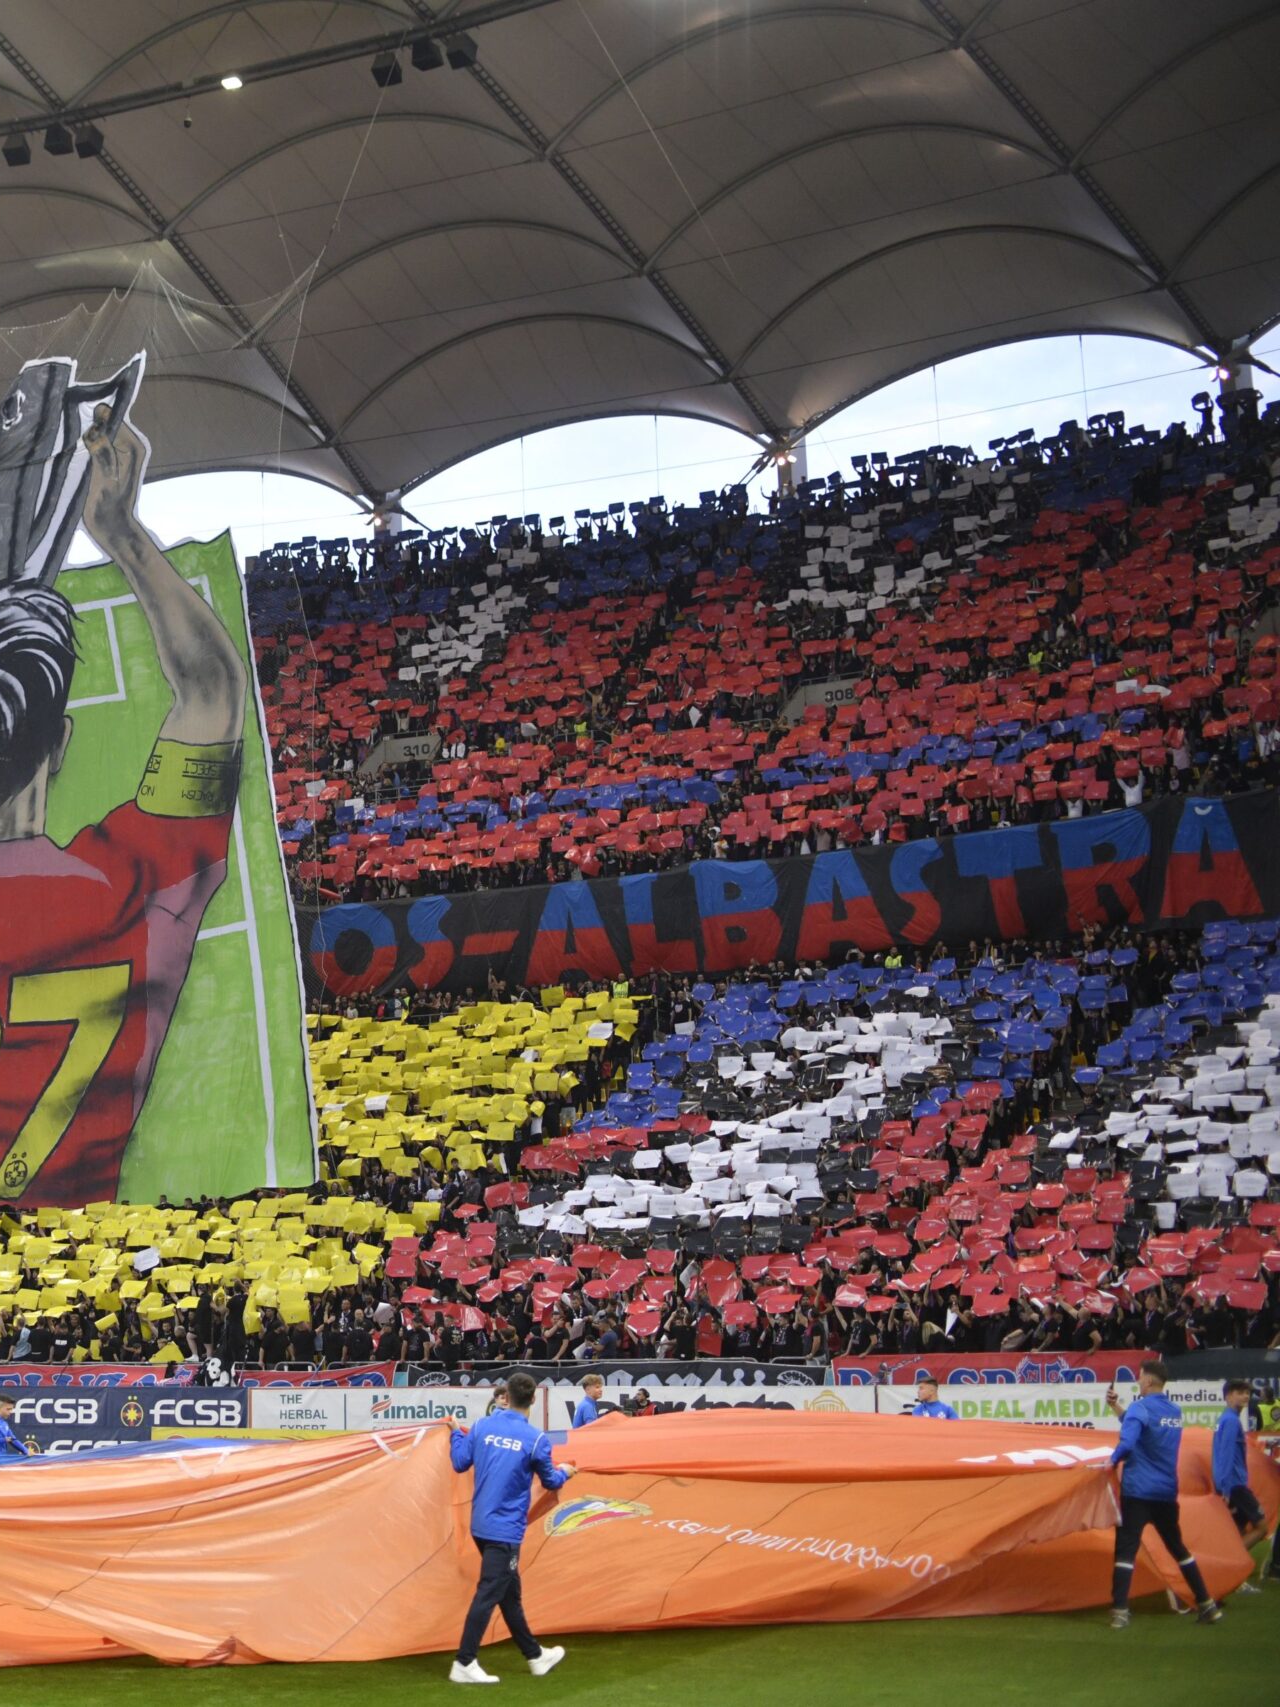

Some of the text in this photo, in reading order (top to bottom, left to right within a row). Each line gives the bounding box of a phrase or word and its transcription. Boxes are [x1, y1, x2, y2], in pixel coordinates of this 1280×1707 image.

[824, 688, 854, 702] 308
[403, 743, 430, 757] 310
[280, 1394, 302, 1404] THE
[371, 1394, 467, 1419] Himalaya
[13, 1398, 98, 1425] FCSB
[149, 1399, 242, 1427] FCSB
[280, 1409, 328, 1419] HERBAL
[952, 1400, 1113, 1419] IDEAL MEDIA
[484, 1434, 522, 1451] FCSB
